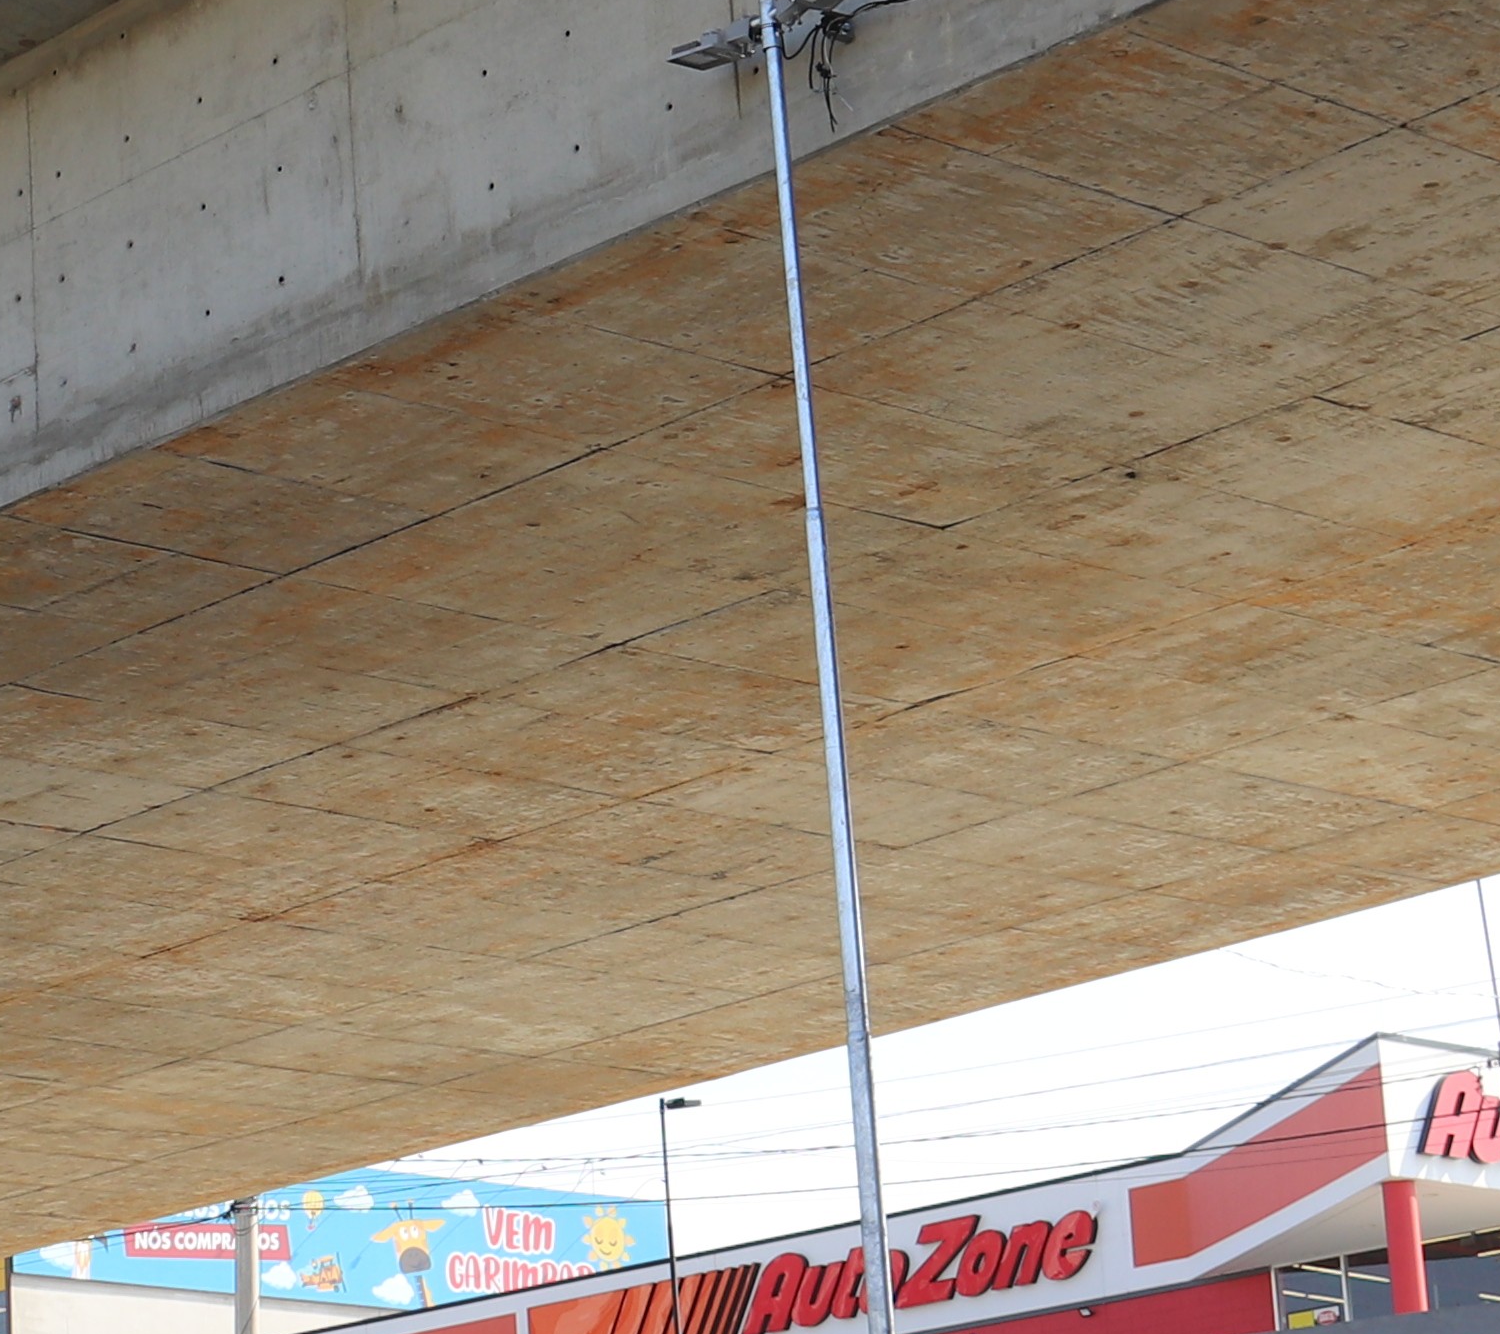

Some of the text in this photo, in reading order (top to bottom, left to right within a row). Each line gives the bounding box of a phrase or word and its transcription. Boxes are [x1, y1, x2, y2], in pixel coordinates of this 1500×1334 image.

[134, 1226, 280, 1251] NÓS COMPROS
[483, 1205, 555, 1254] VEM
